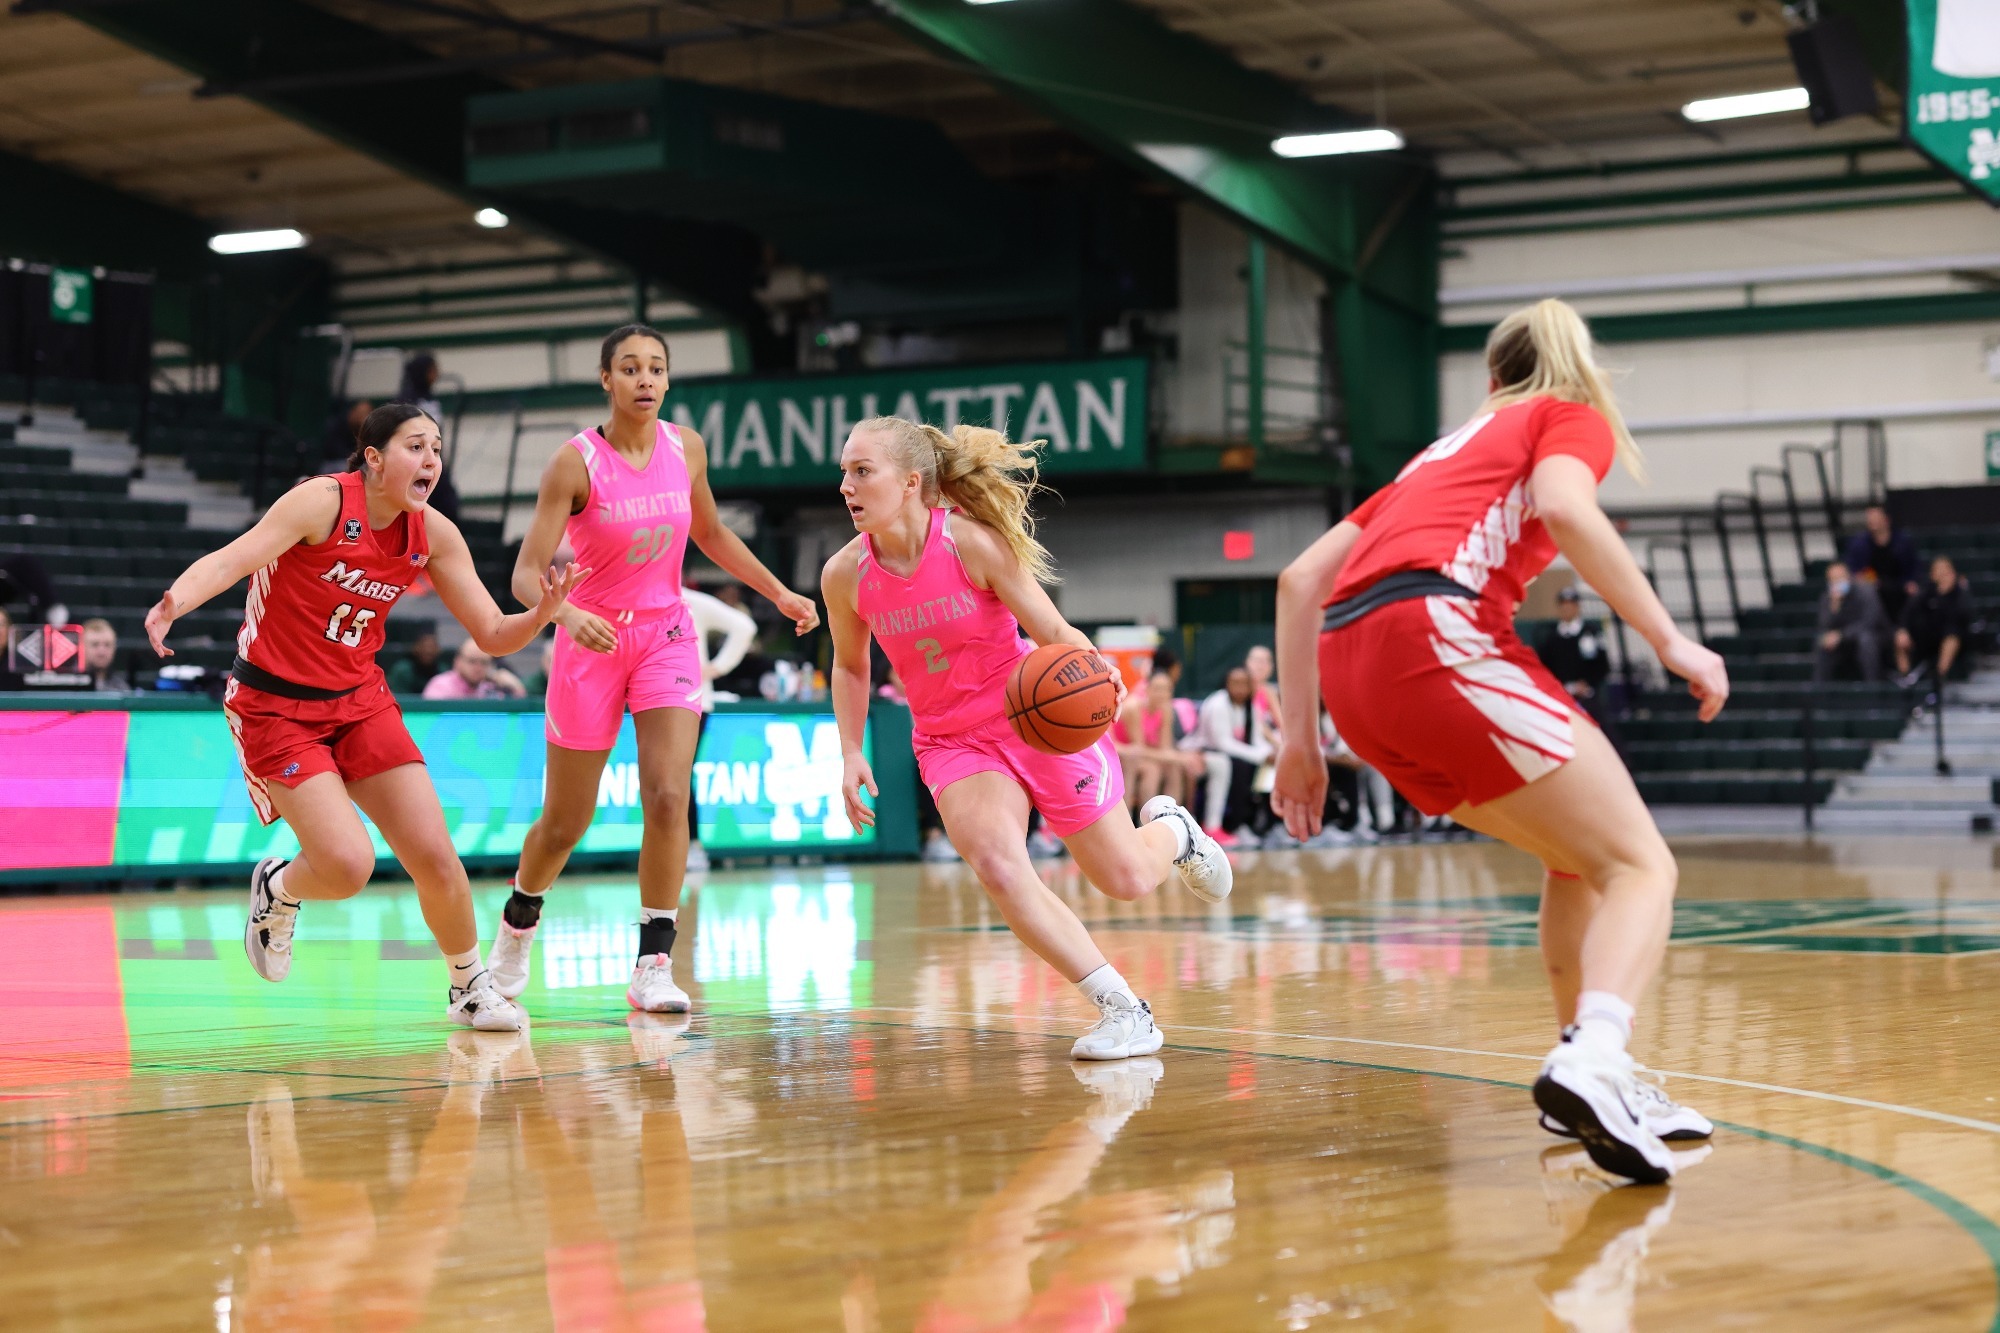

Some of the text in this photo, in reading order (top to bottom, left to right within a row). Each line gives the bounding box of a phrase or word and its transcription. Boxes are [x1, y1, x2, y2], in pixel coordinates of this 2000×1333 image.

[598, 490, 690, 524] MANHATTAN
[626, 524, 674, 564] 20
[320, 560, 408, 602] MARIS
[865, 588, 978, 635] MANHATTAN
[914, 637, 951, 675] 2
[1053, 655, 1108, 687] THE RO
[1091, 708, 1112, 722] ROCK
[541, 761, 760, 805] NHTAN
